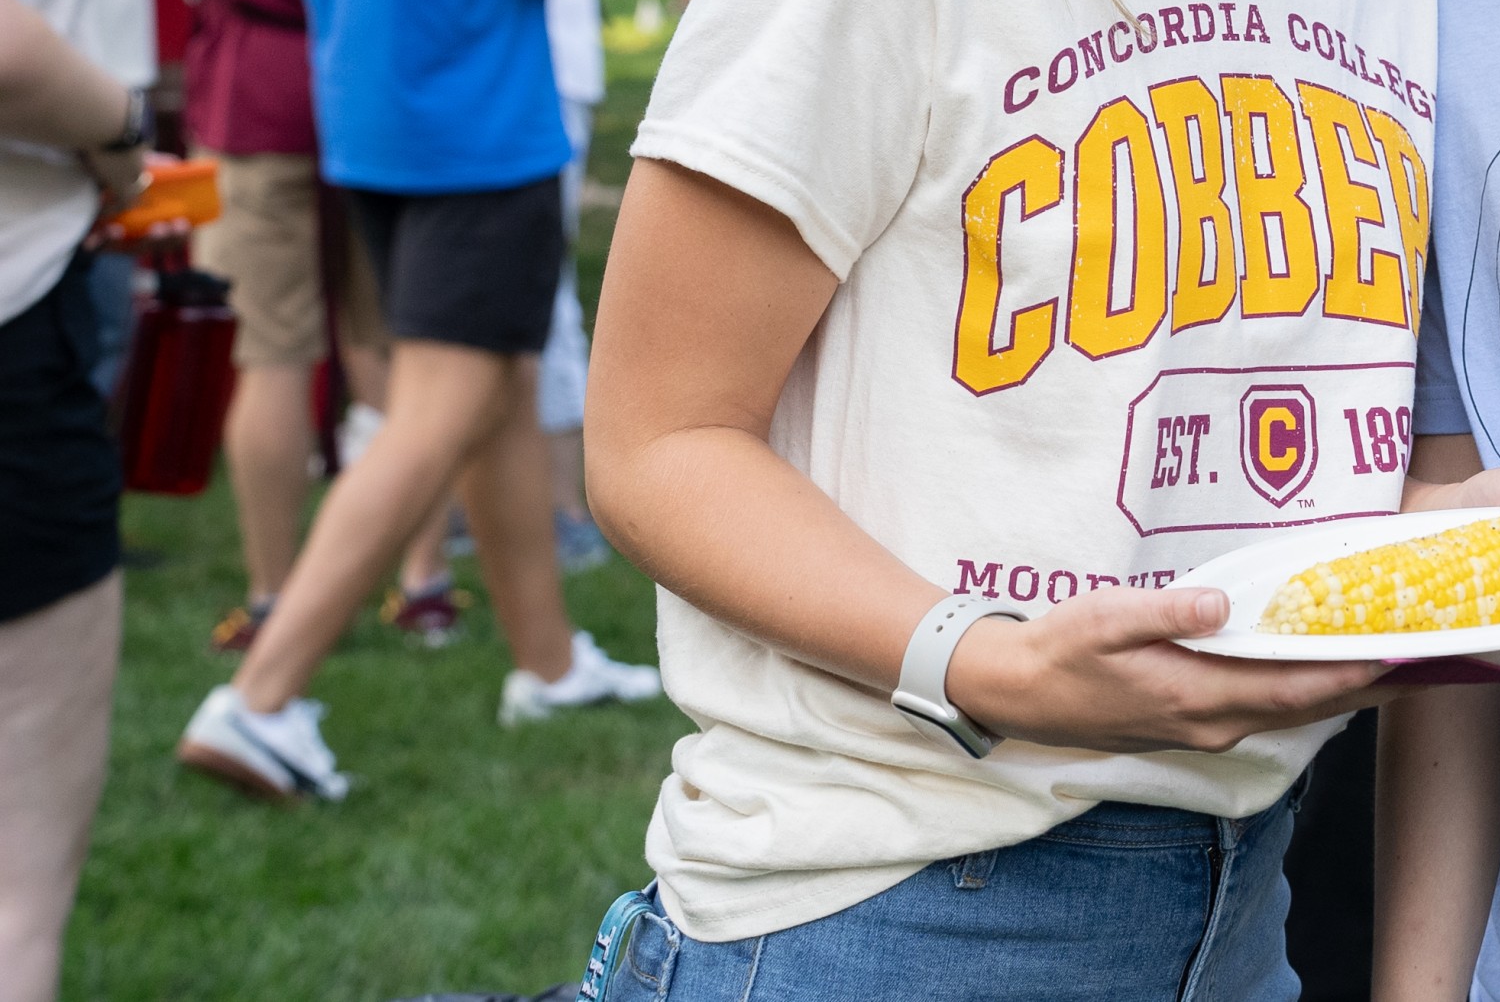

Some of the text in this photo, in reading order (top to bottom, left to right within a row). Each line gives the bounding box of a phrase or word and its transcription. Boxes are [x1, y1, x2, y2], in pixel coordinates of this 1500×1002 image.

[1003, 2, 1437, 124] CONCORDIA COLLEG
[1150, 413, 1219, 490] EST.
[1259, 406, 1298, 472] C
[1297, 498, 1316, 509] TM
[577, 925, 617, 1002] TH
